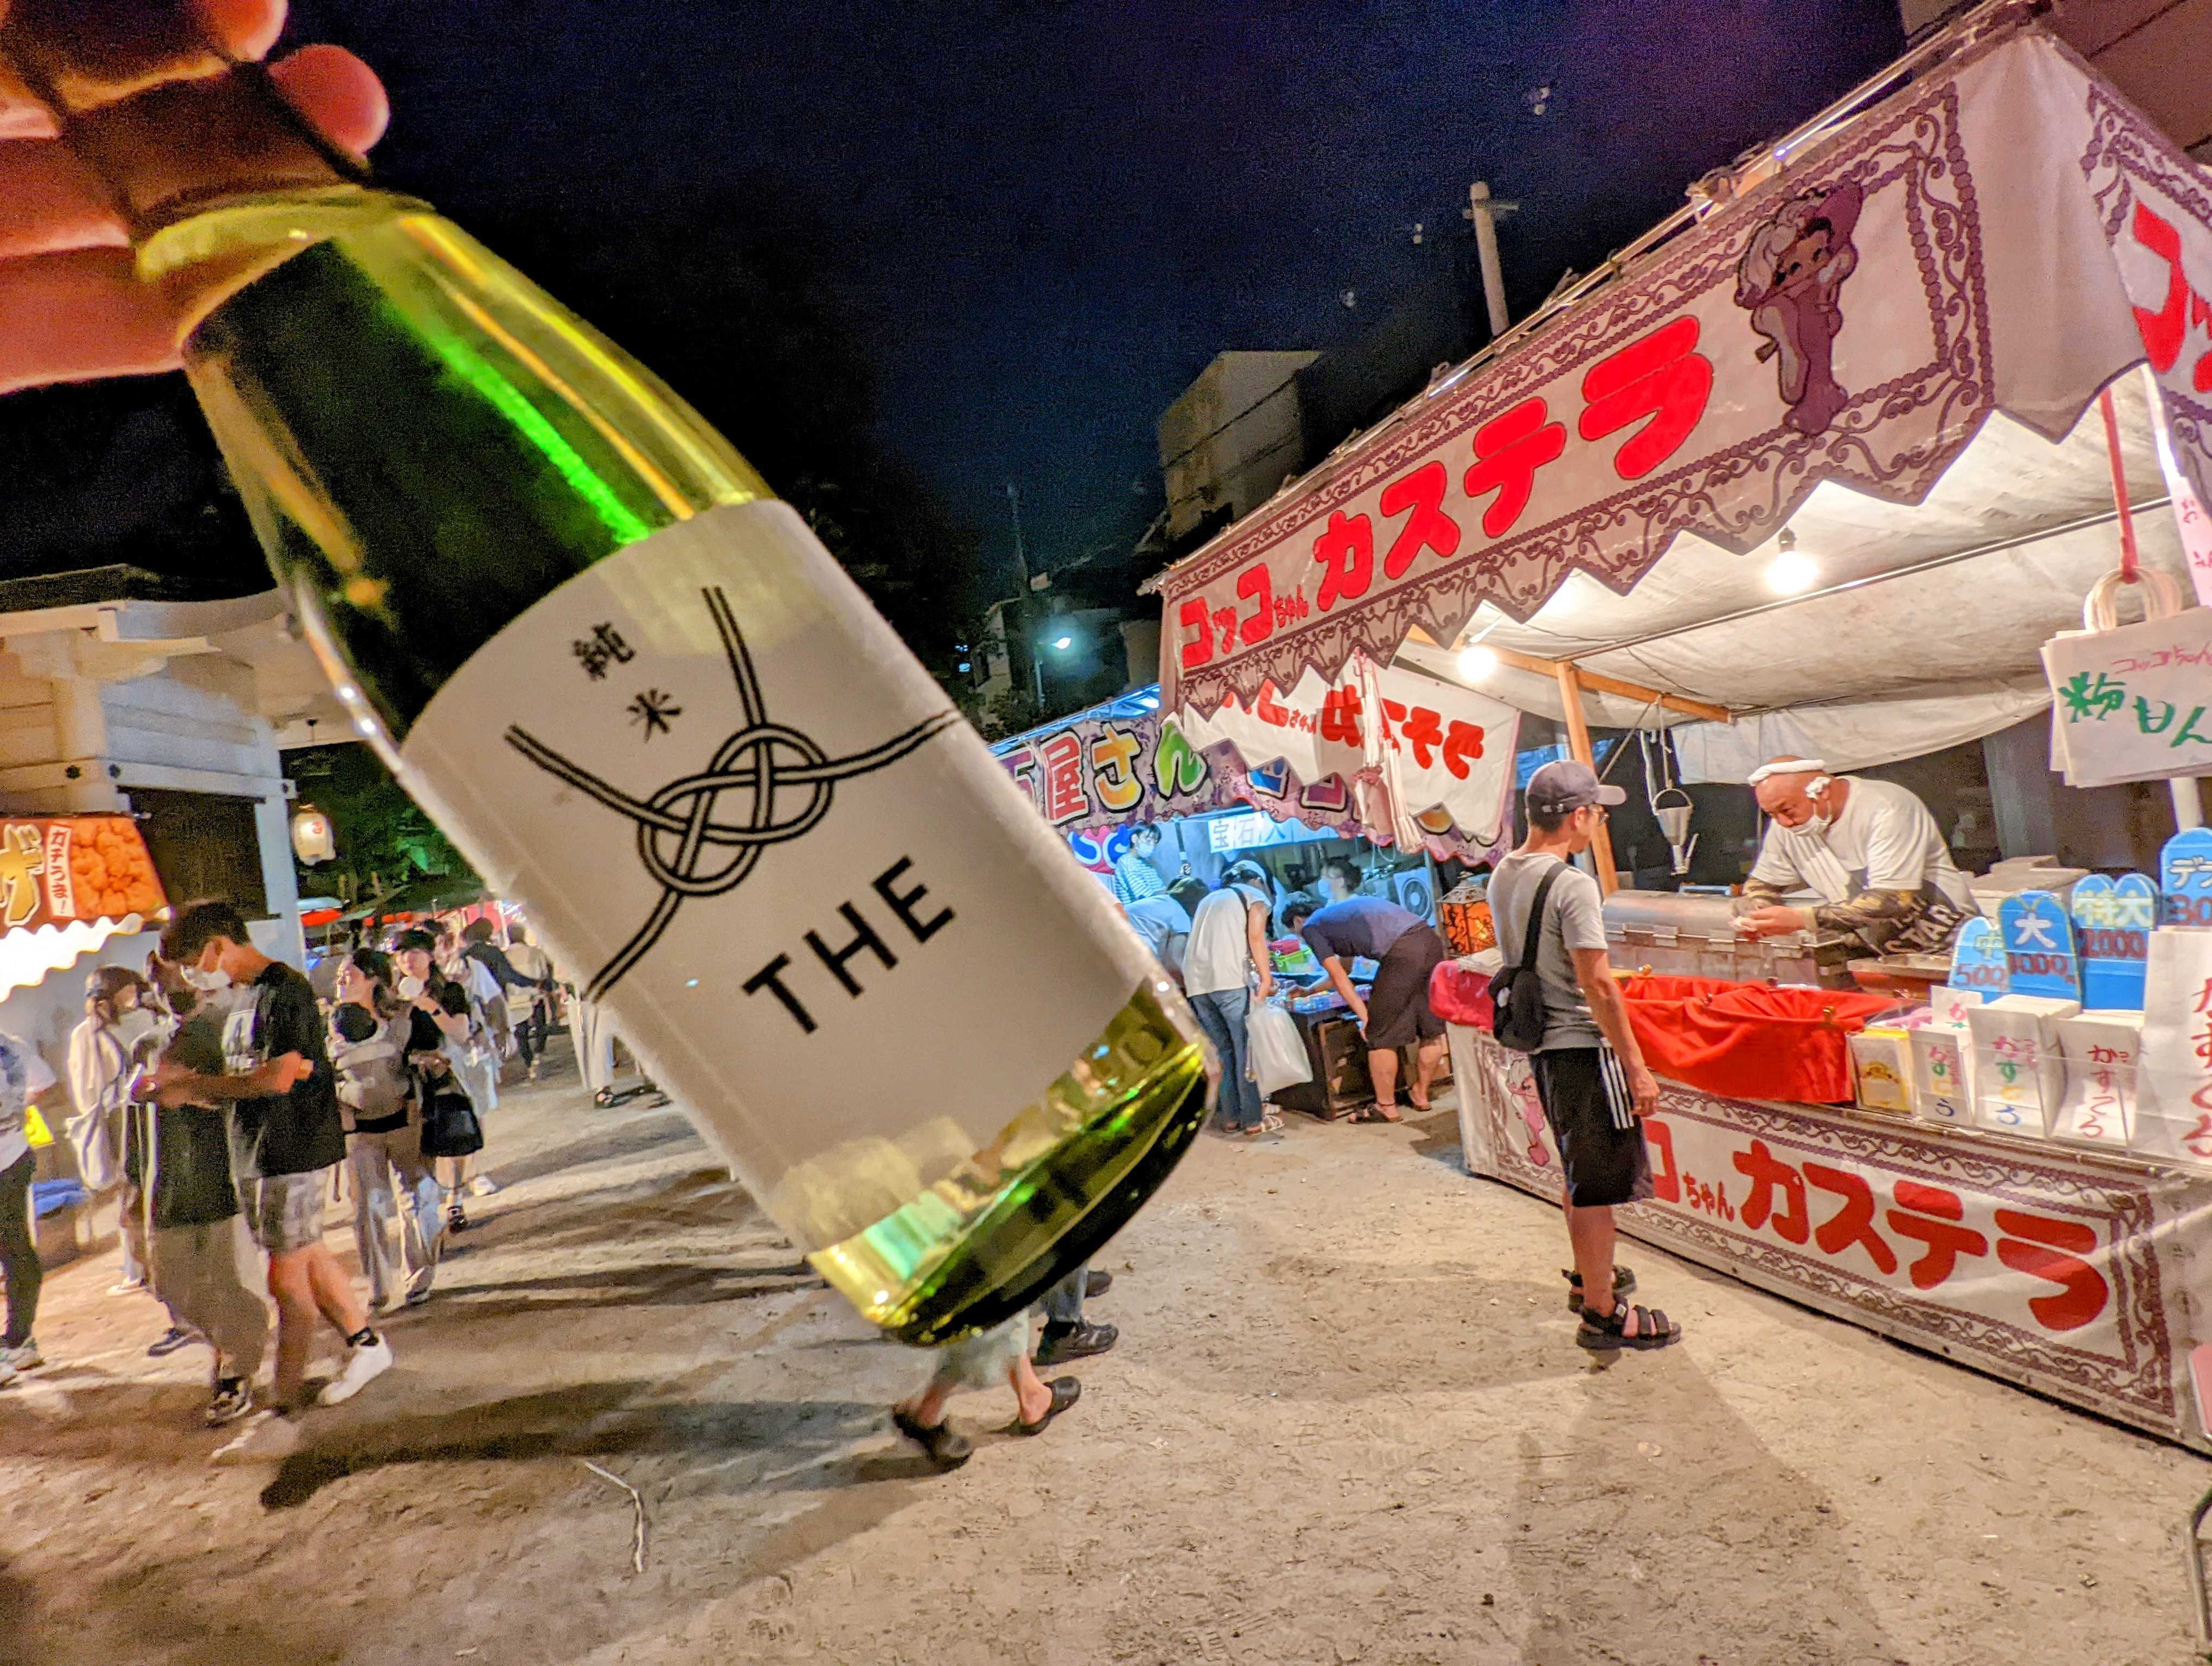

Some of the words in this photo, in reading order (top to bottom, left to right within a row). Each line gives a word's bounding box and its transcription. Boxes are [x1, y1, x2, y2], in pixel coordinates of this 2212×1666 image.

[1180, 315, 1713, 669] コッコちゃんカステラ
[572, 620, 683, 742] 純米
[742, 855, 956, 1034] THE
[2015, 912, 2057, 949] 大
